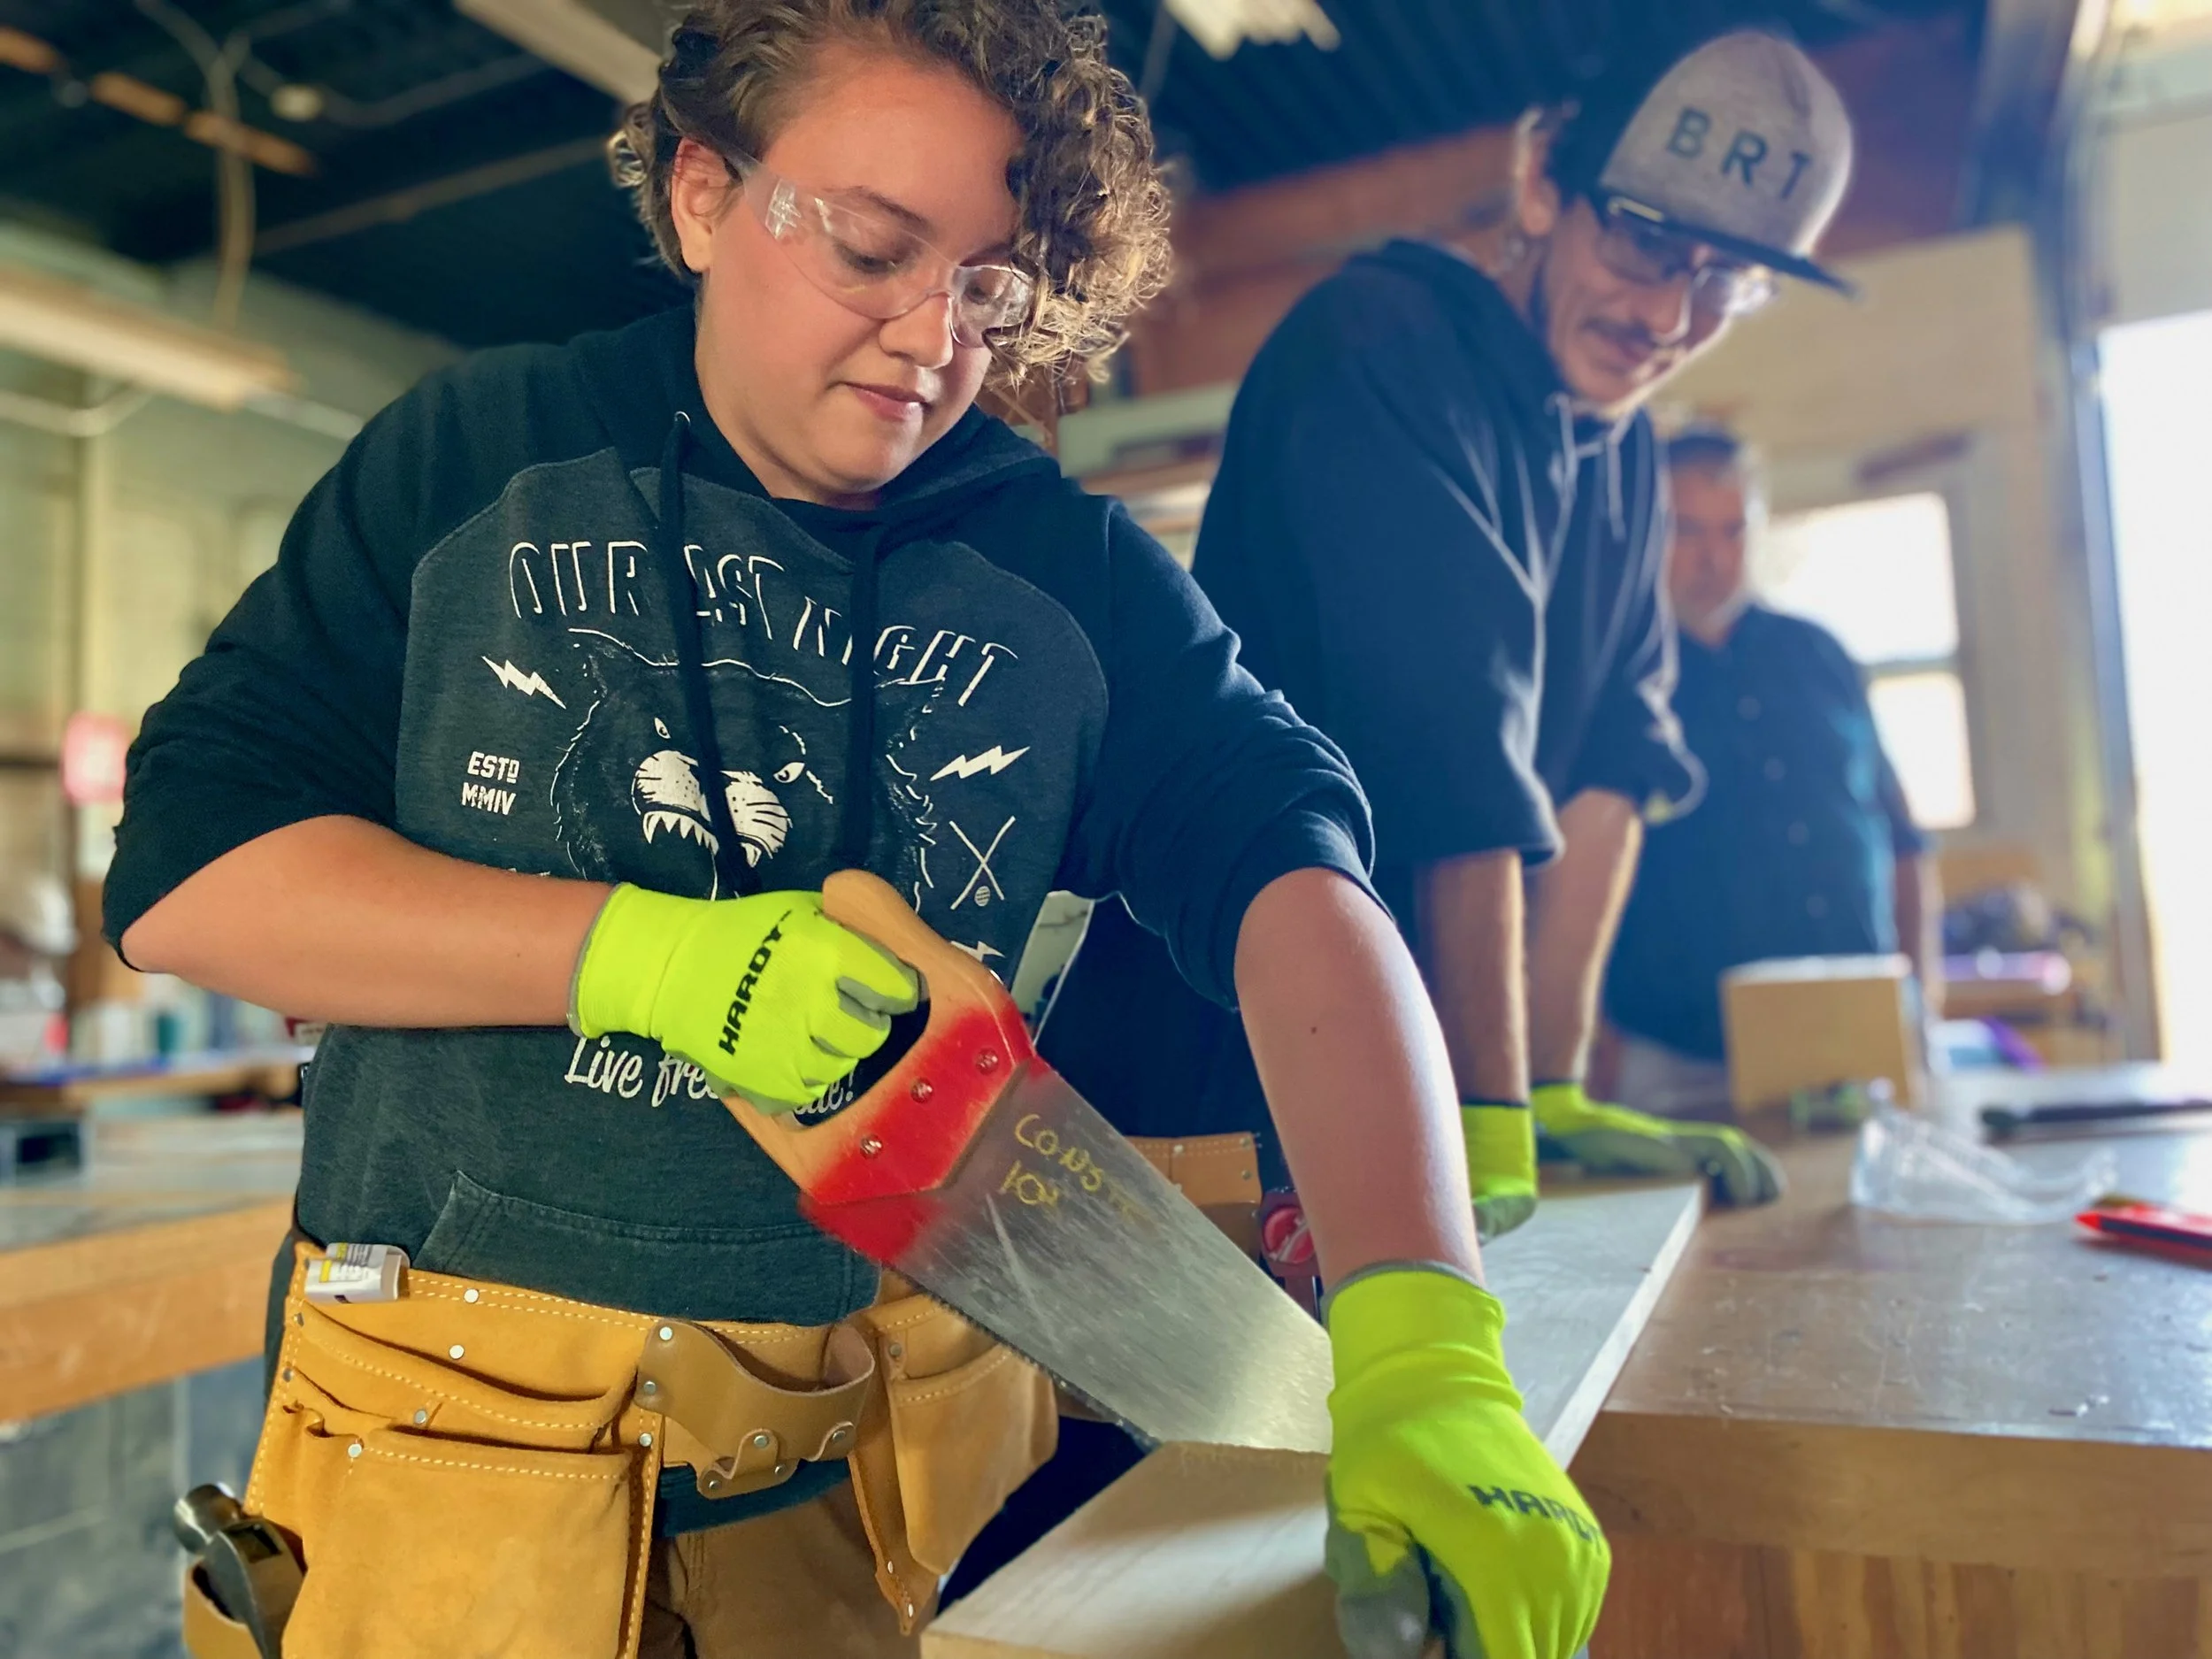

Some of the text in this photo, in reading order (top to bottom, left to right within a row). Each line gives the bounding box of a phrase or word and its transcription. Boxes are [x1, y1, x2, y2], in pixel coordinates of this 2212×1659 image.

[509, 541, 1018, 707] OUR AST NGHT
[461, 781, 517, 816] MMIV
[467, 750, 520, 784] ESTD
[718, 923, 783, 1056] HARDY
[564, 1033, 643, 1099] Live
